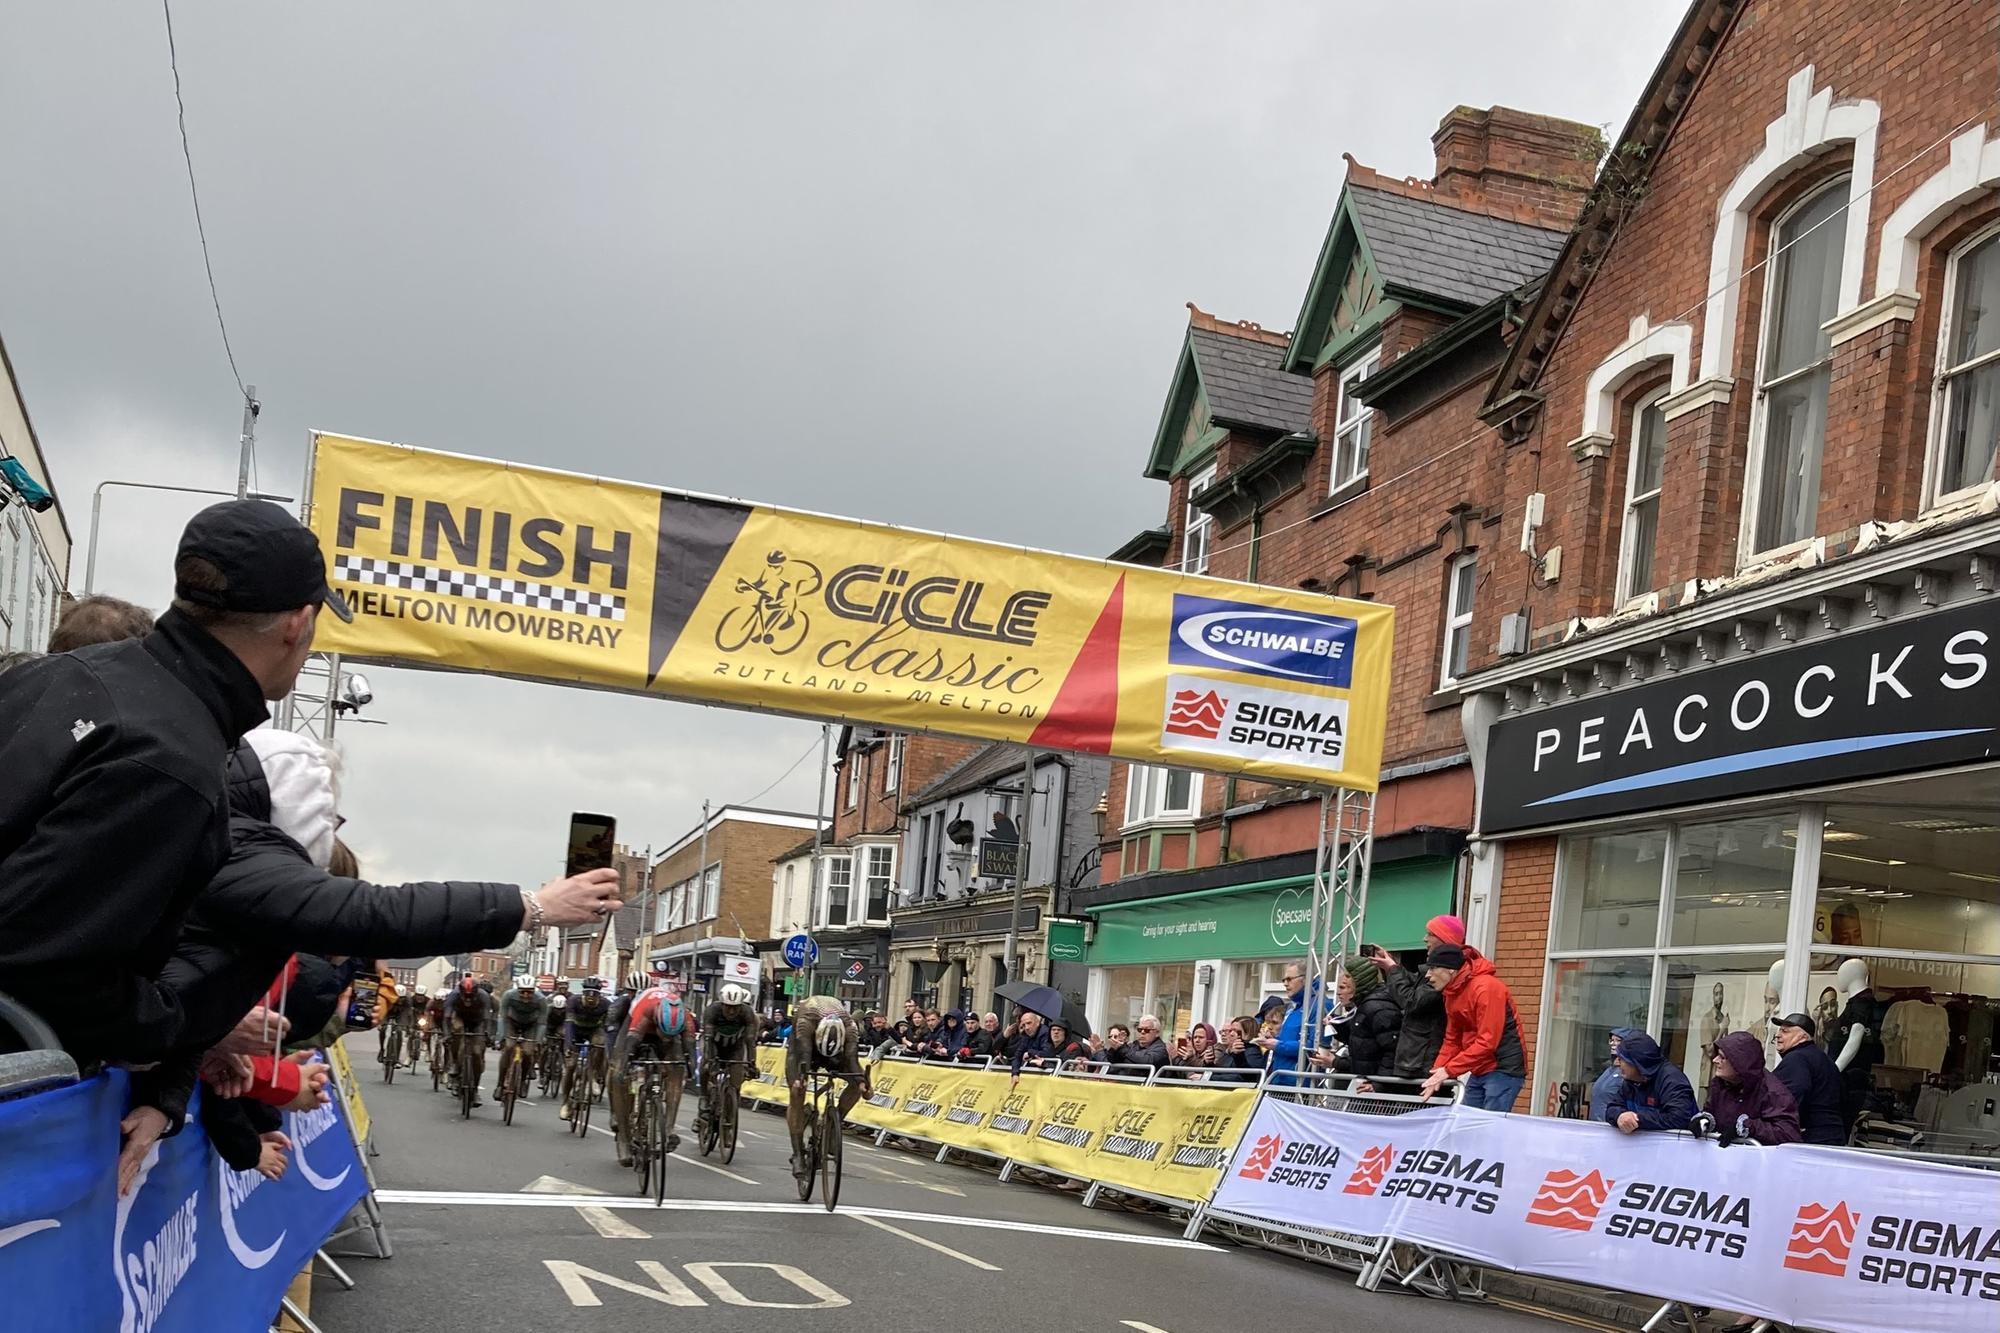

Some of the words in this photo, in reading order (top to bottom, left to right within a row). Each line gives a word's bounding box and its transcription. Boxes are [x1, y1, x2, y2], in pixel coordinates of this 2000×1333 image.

[336, 488, 631, 590] FINISH
[335, 588, 457, 625] MELTON
[465, 606, 623, 649] MOWBRAY
[817, 616, 1044, 694] classic
[1208, 625, 1345, 659] SCHWALBE
[713, 662, 868, 694] RUTLAND
[908, 689, 1038, 719] MELTON
[1533, 630, 1989, 772] PEACOCKS
[1229, 726, 1342, 756] SPORTS
[1235, 701, 1343, 737] SIGMA
[1276, 909, 1311, 927] Specsave
[1281, 1142, 1339, 1169] SIGMA
[1395, 1149, 1504, 1189] SIGMA
[1268, 1166, 1331, 1191] SPORTS
[1381, 1178, 1500, 1215] SPORTS
[1619, 1183, 1750, 1229] SIGMA
[1605, 1214, 1747, 1259] SPORTS
[543, 1260, 852, 1309] NO
[1859, 1256, 2000, 1301] SPORTS
